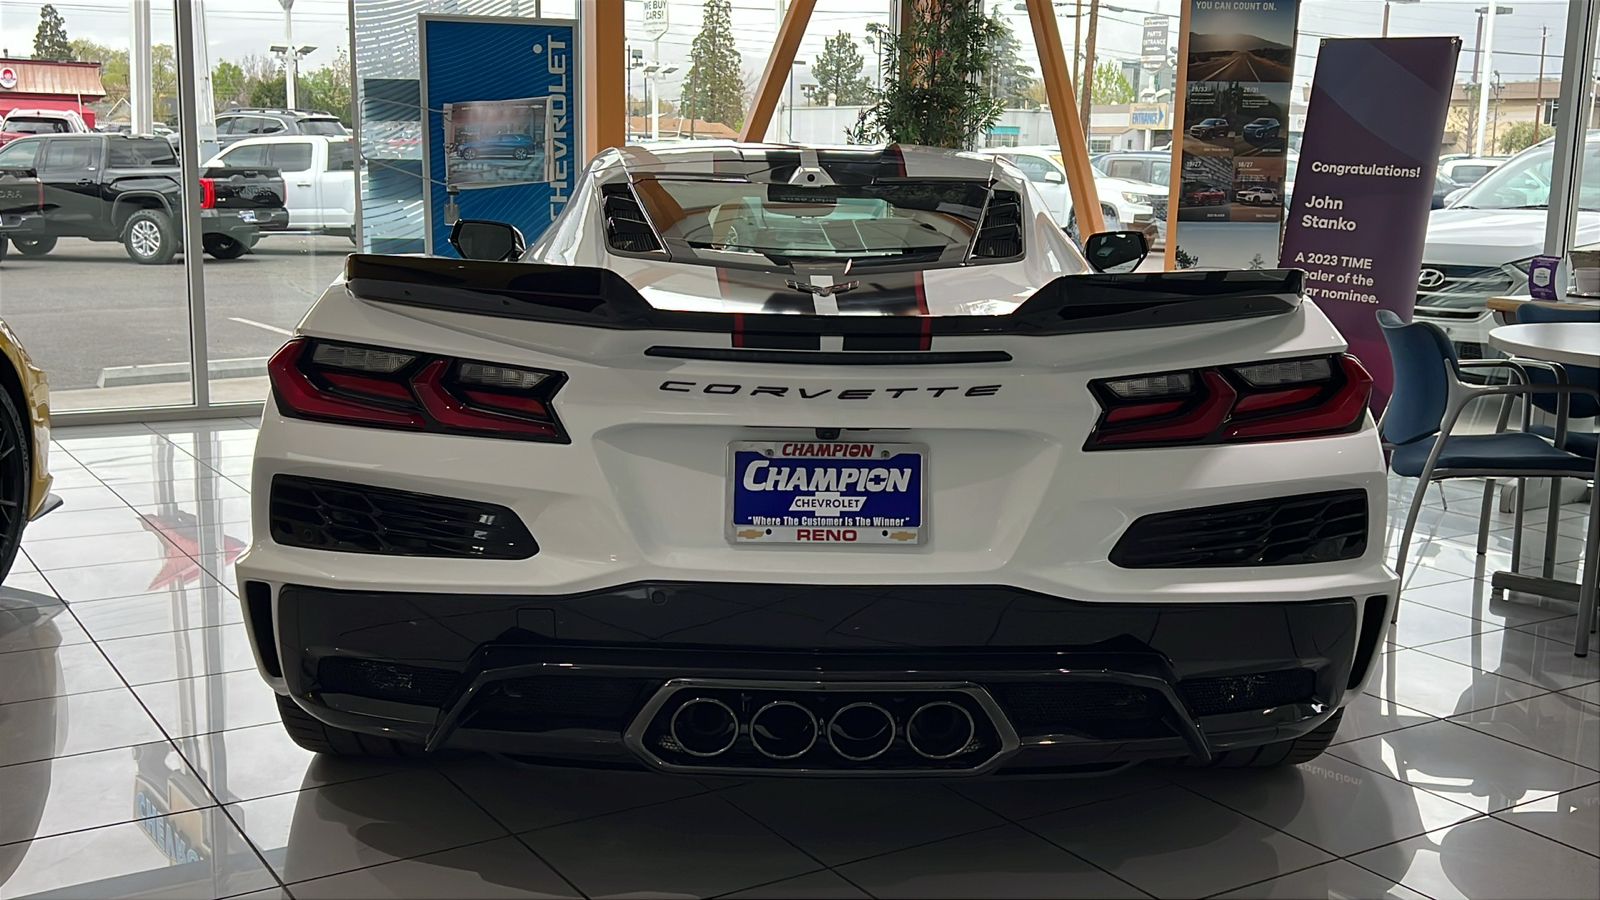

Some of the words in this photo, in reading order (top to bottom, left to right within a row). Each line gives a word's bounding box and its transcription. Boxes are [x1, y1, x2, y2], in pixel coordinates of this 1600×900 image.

[644, 1, 652, 10] WE
[652, 0, 667, 9] BUY
[1196, 2, 1213, 10] YOU
[1214, 2, 1232, 10] CAN
[1233, 2, 1261, 10] COUNT
[1262, 3, 1277, 11] ON.
[646, 10, 664, 20] CARS!
[1143, 38, 1166, 46] ENTRANCE
[1132, 112, 1159, 126] ENTRANCE
[1311, 161, 1421, 178] Congratulations!
[1305, 195, 1343, 210] John
[1301, 214, 1357, 231] Stanko
[1294, 252, 1305, 262] A
[1307, 253, 1338, 266] 2023
[1341, 256, 1373, 269] TIME
[1304, 269, 1335, 282] ealer
[1336, 272, 1351, 284] of
[1352, 274, 1374, 287] the
[1304, 286, 1319, 296] ar
[1321, 287, 1379, 304] nominee.
[659, 380, 1002, 400] CORVETTE
[782, 443, 874, 458] CHAMPION
[795, 498, 861, 509] CHEVROLET
[783, 516, 799, 526] The
[801, 517, 843, 526] Customer
[845, 517, 853, 526] Is
[855, 517, 871, 526] The
[796, 529, 858, 541] RENO
